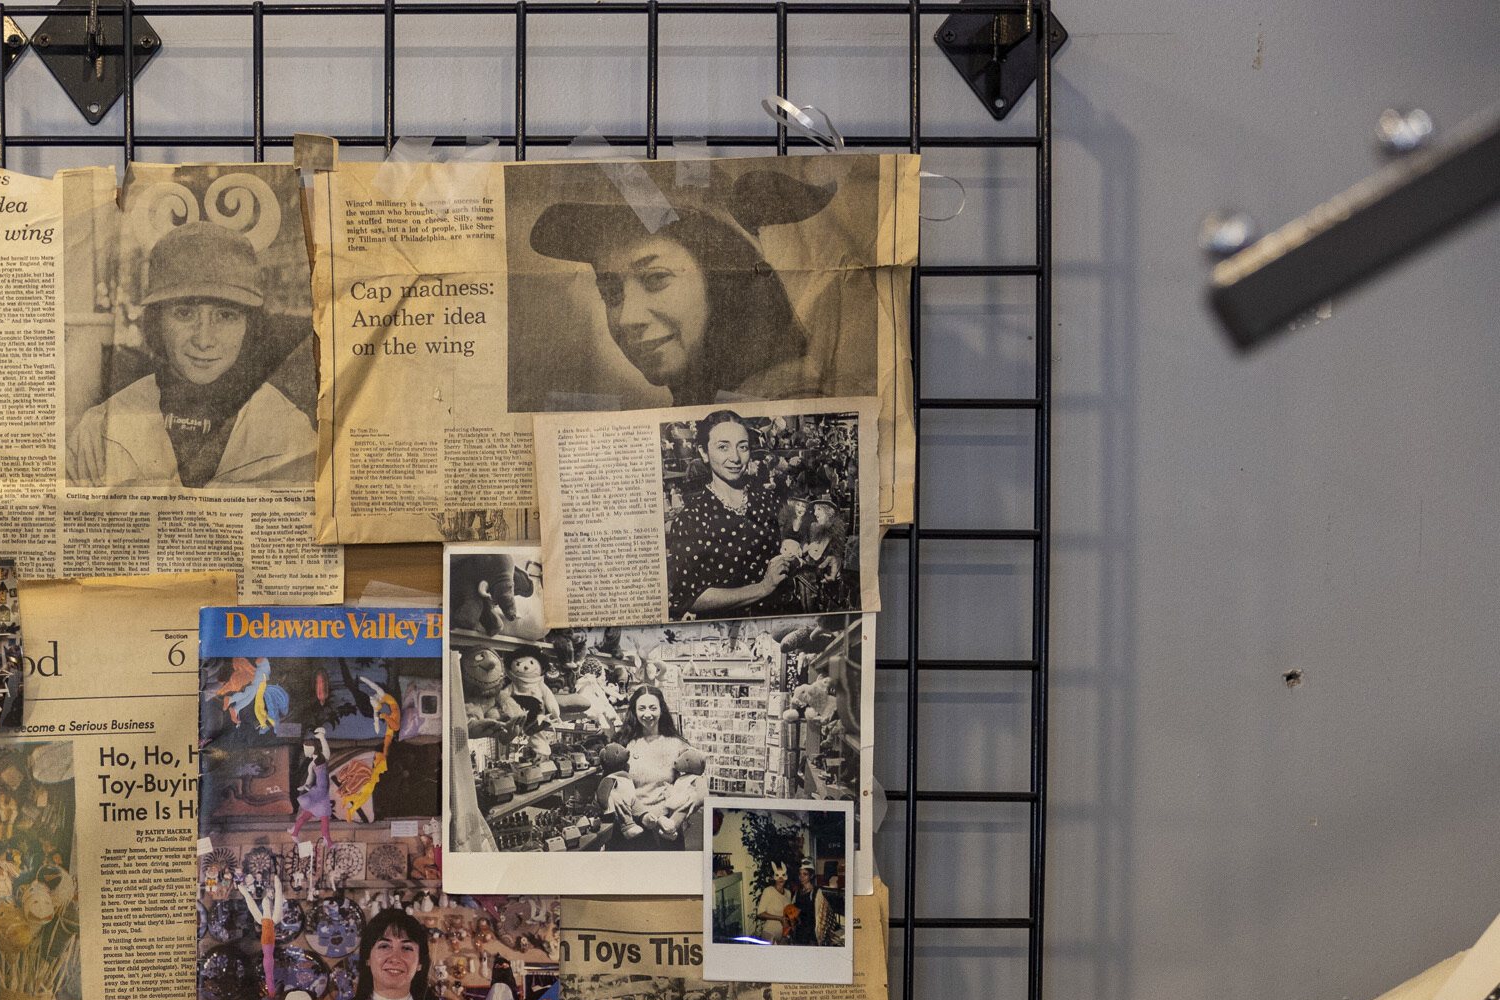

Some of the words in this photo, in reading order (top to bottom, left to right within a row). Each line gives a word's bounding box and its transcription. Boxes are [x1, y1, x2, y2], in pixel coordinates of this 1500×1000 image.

[5, 224, 54, 244] wing
[351, 281, 391, 302] Cap
[400, 278, 494, 298] madness:
[352, 308, 435, 328] Another
[444, 307, 486, 324] idea
[352, 343, 375, 356] on
[383, 337, 416, 355] the
[425, 336, 475, 357] wing
[225, 612, 345, 640] Delaware
[347, 612, 422, 645] Valley
[168, 641, 185, 666] 6
[100, 747, 136, 770] Ho,
[145, 745, 180, 768] Ho,
[100, 803, 147, 822] Time
[156, 801, 170, 820] Is
[578, 934, 641, 969] Toys
[649, 937, 703, 966] This
